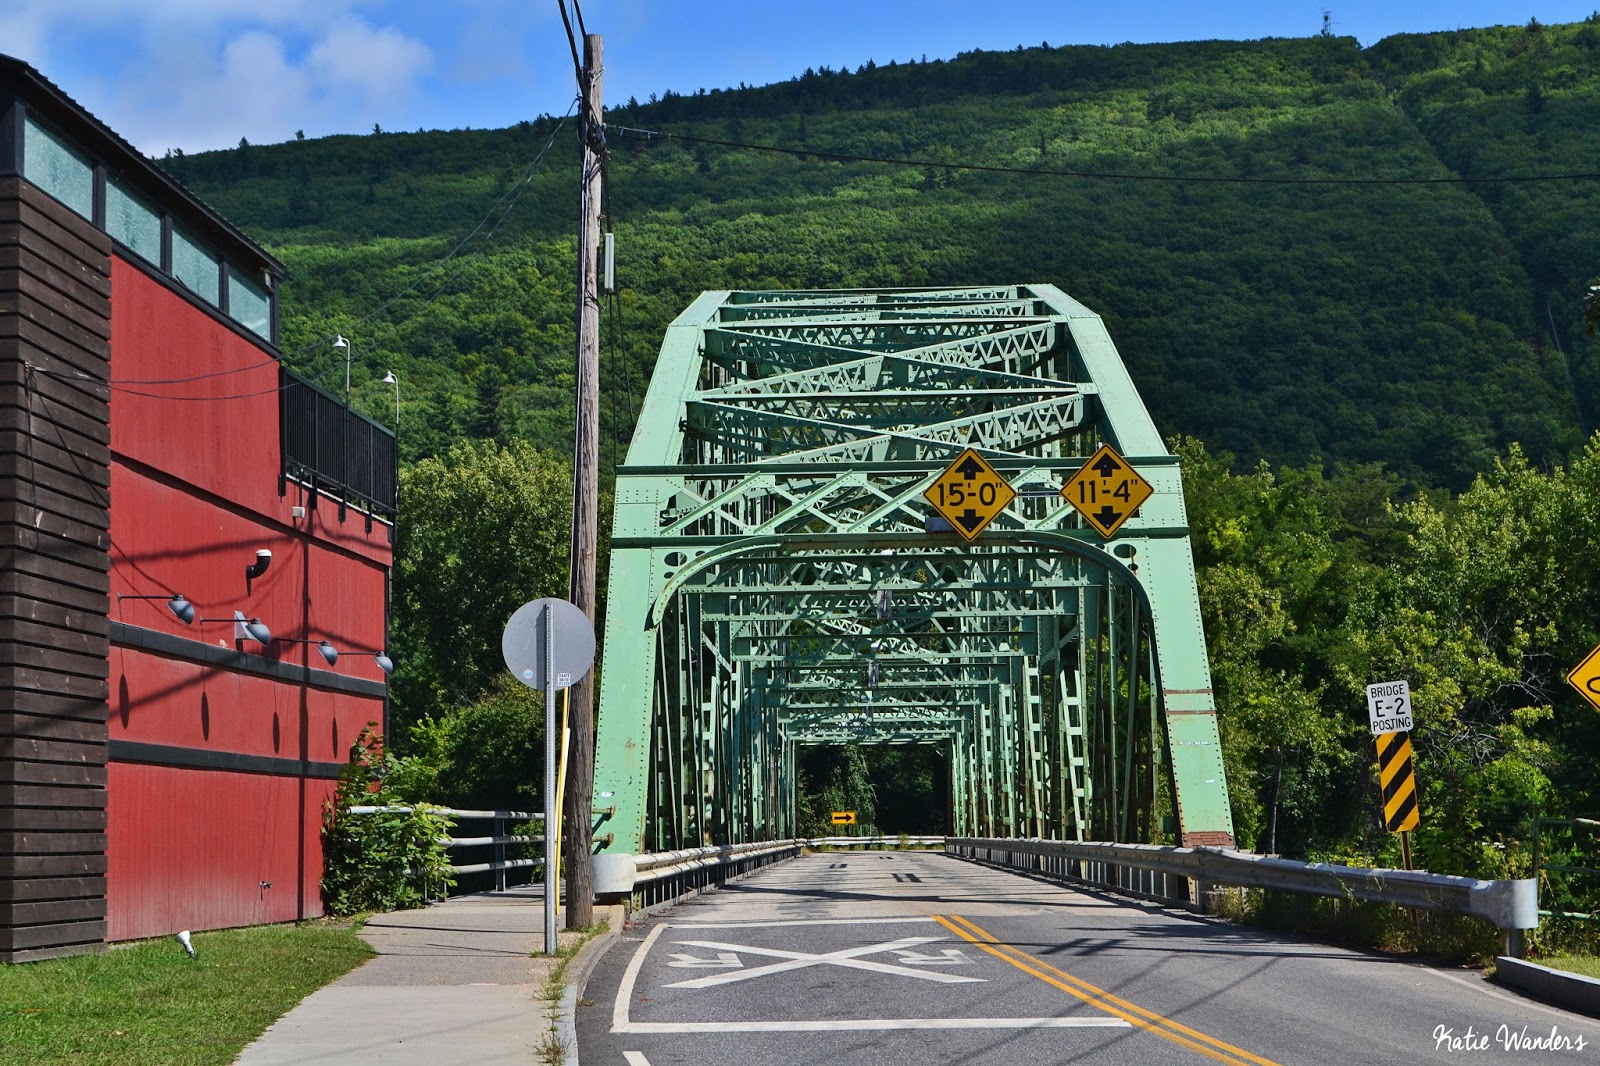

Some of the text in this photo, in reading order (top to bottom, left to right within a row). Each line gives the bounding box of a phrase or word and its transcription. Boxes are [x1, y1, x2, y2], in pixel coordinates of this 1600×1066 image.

[1370, 684, 1405, 698] BRIDGE
[1375, 697, 1406, 717] E-2
[1373, 717, 1411, 731] POSTING
